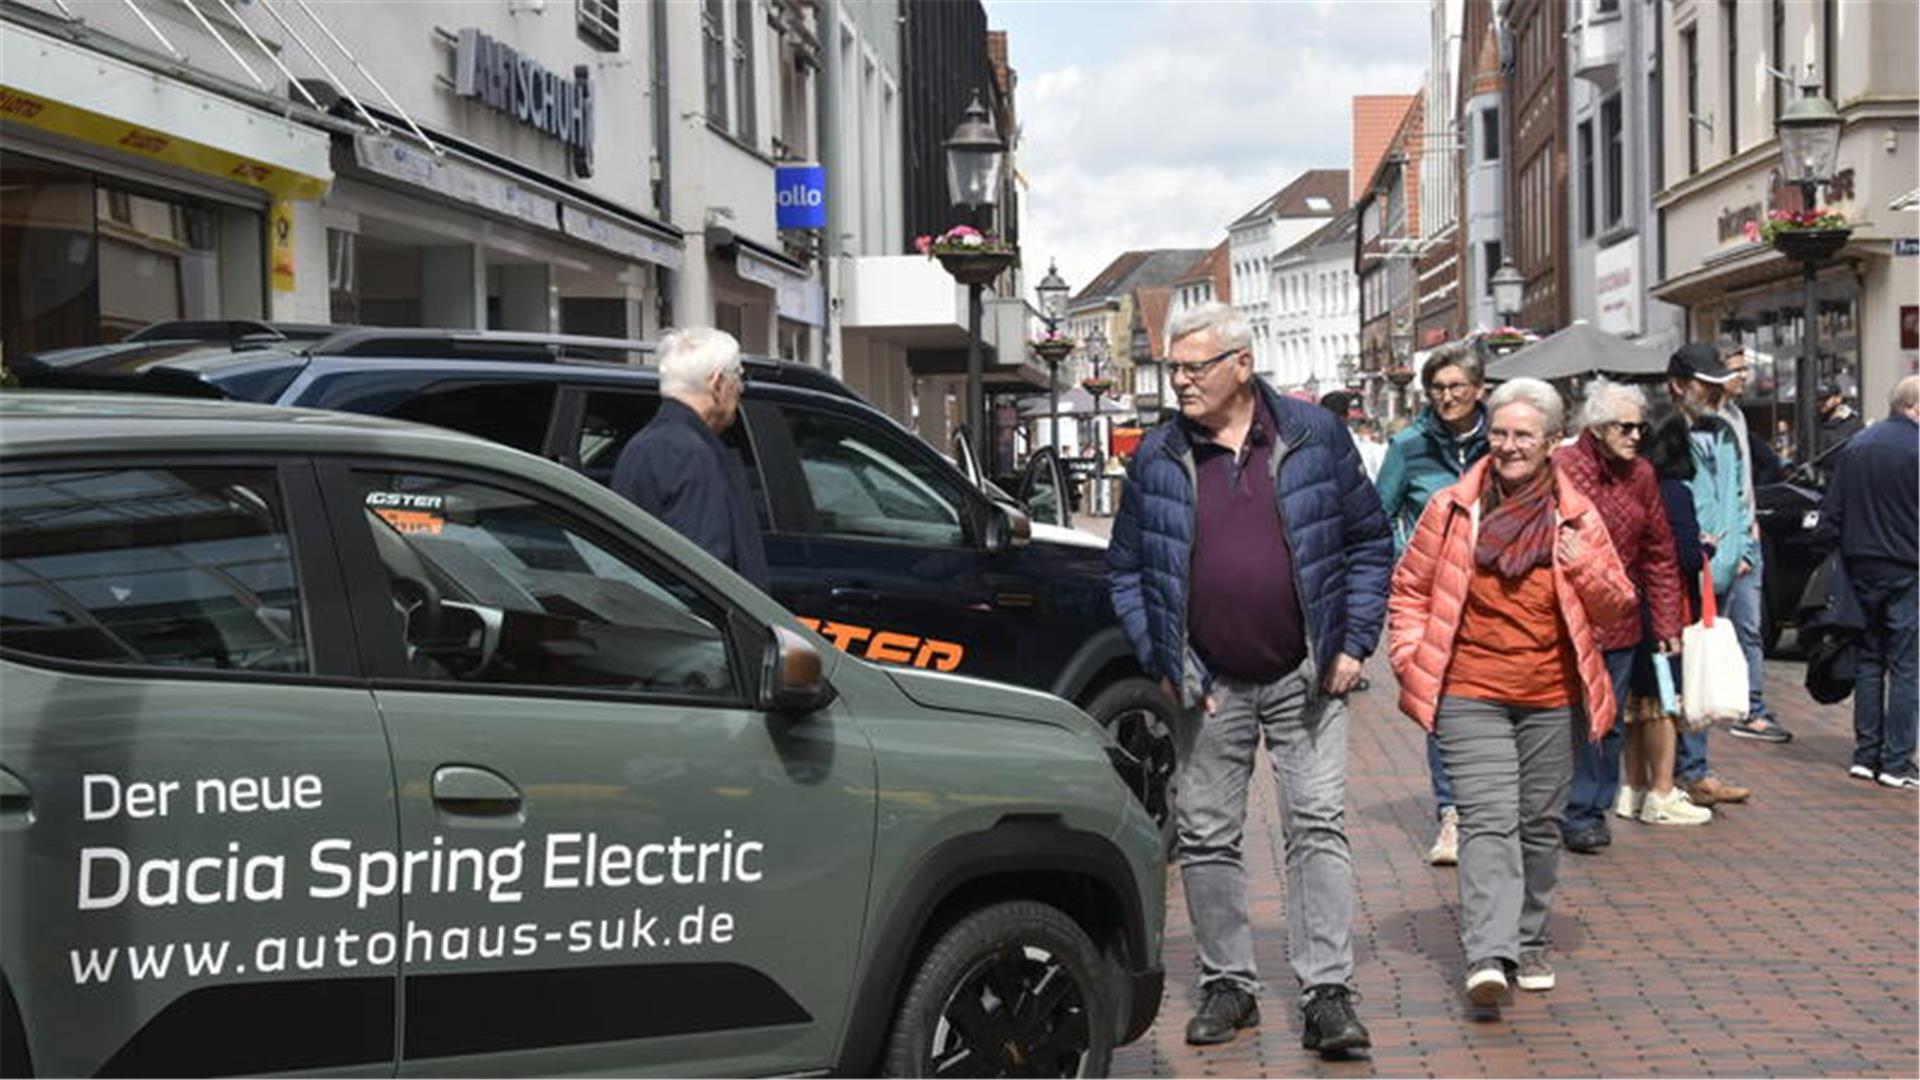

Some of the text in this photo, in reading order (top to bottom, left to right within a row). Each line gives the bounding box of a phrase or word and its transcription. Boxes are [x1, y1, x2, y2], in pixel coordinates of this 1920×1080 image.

[796, 615, 964, 672] TER
[83, 773, 323, 821] Der neue
[78, 829, 764, 910] Dacia Spring Electric
[70, 904, 735, 984] www.autohaus-suk.de
